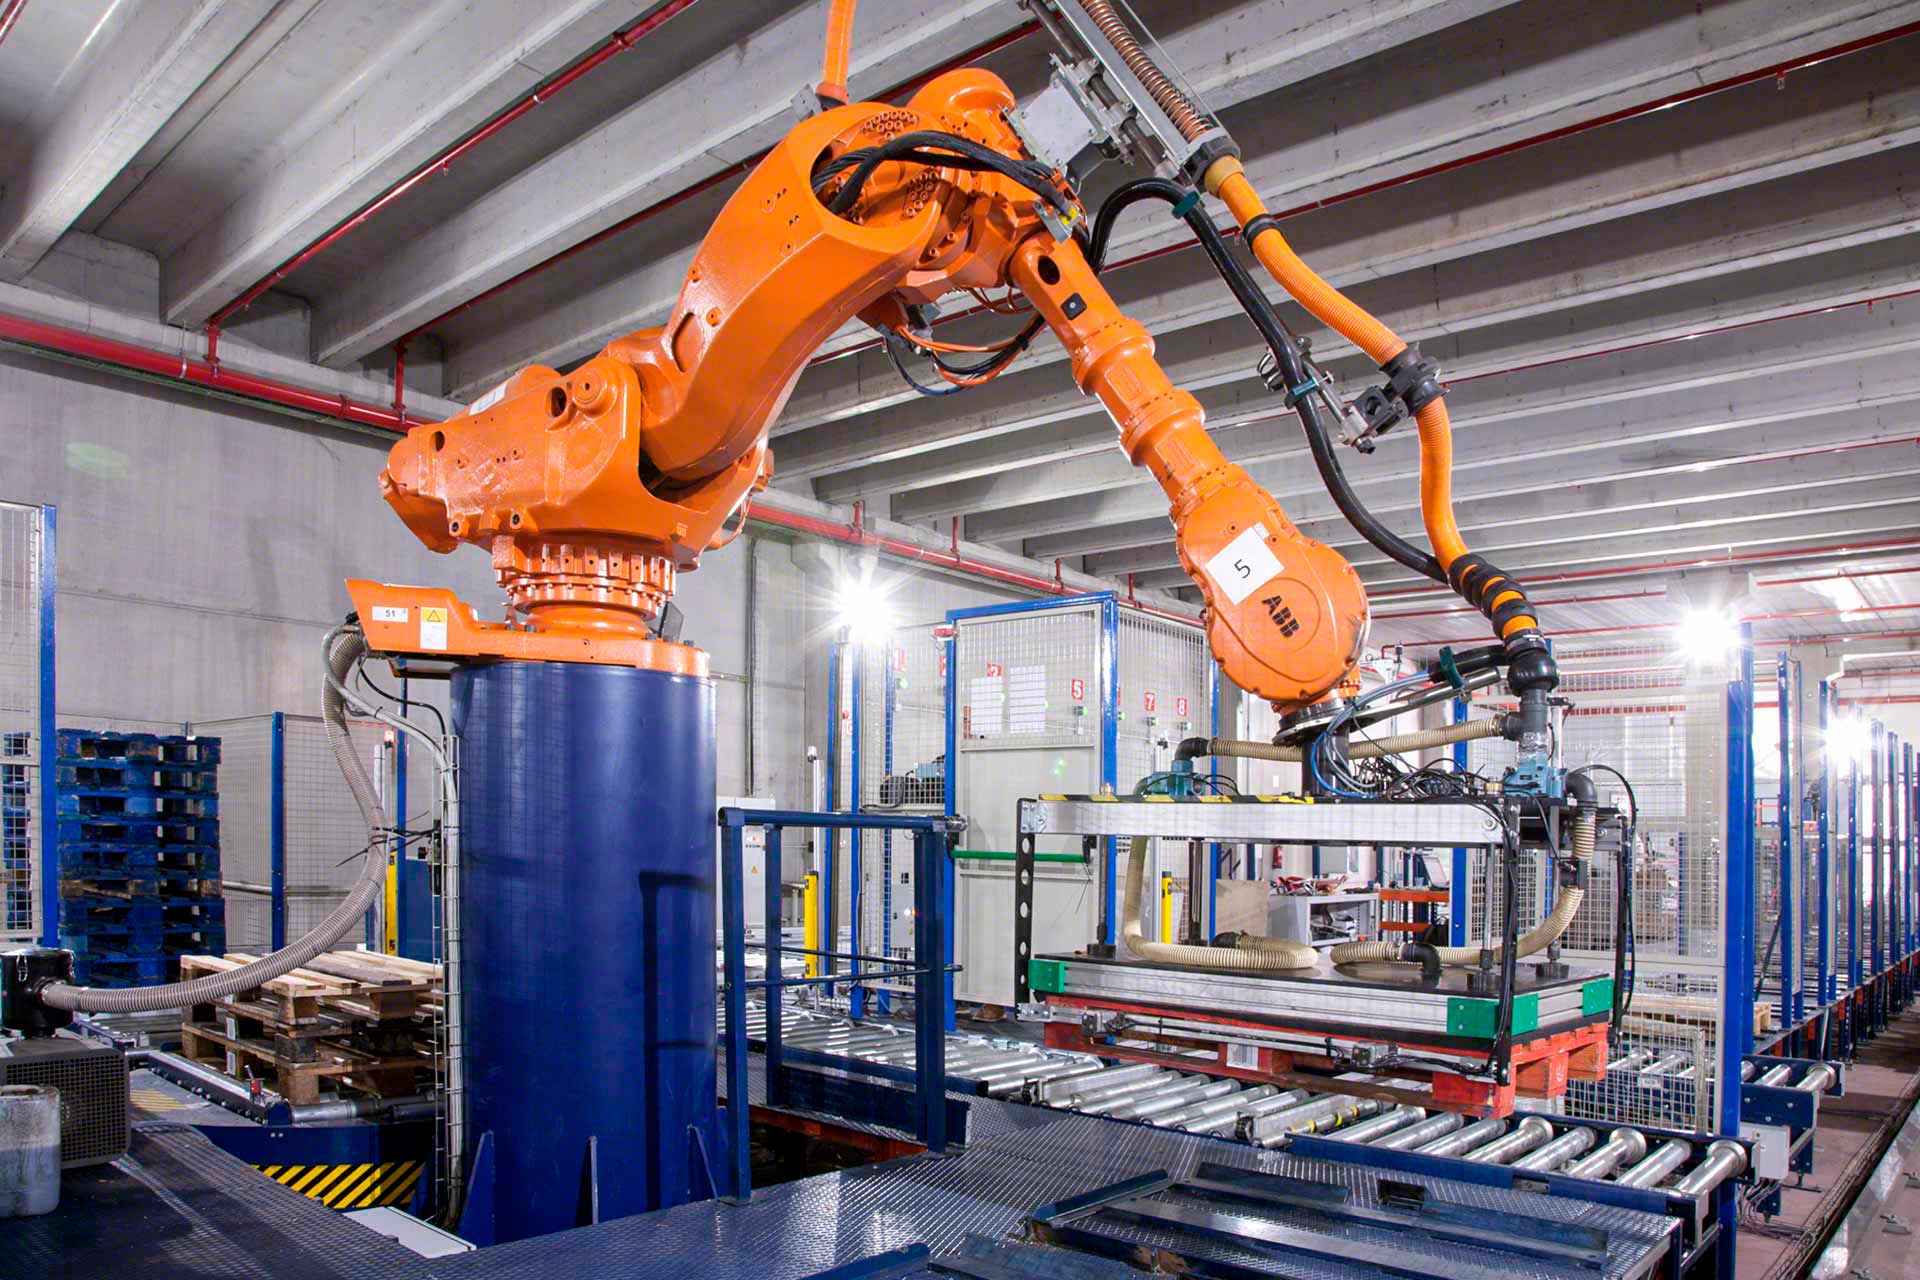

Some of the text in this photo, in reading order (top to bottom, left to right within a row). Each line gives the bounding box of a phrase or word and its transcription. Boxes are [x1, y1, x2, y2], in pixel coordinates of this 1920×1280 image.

[1234, 559, 1251, 579] 5
[1262, 595, 1300, 638] ABB
[1073, 681, 1082, 698] 5
[1146, 694, 1154, 710] 7
[1178, 699, 1185, 715] 8
